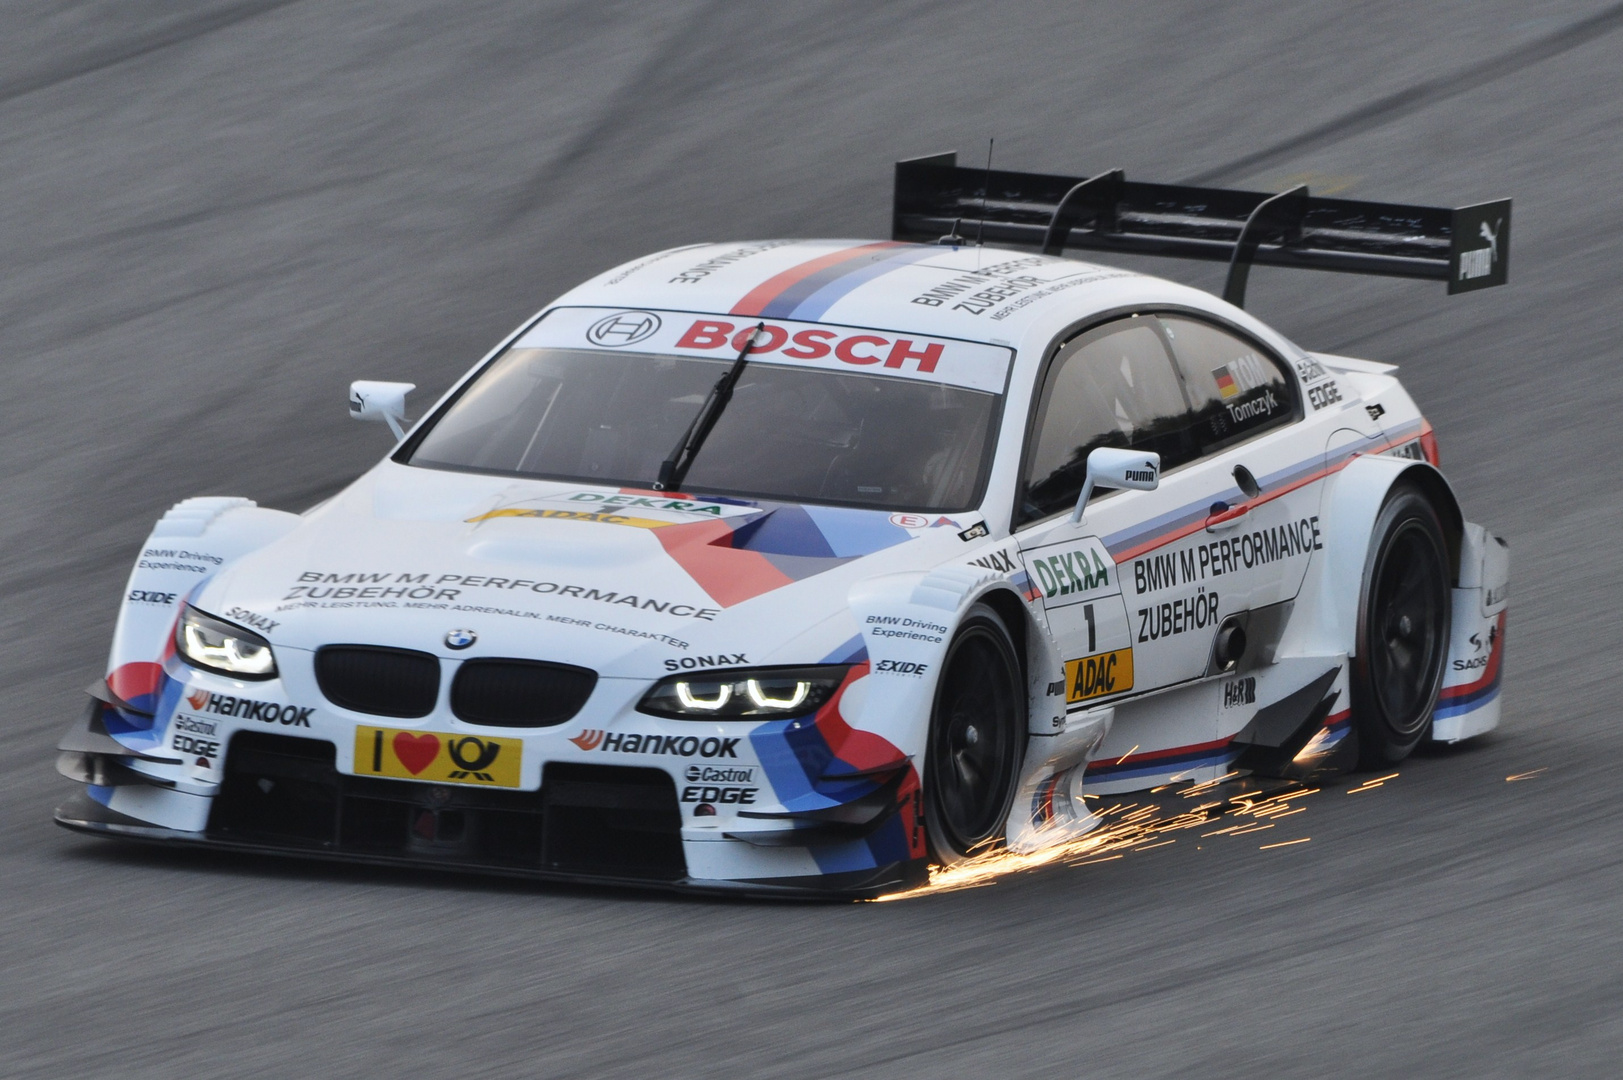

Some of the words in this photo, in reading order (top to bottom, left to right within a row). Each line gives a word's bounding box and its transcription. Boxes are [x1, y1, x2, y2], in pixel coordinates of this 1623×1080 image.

[910, 281, 972, 307] BMW
[675, 319, 945, 373] BOSCH
[1226, 389, 1278, 423] Tomczyk
[1308, 380, 1342, 411] EDGE
[1125, 470, 1154, 482] PUMA
[569, 493, 721, 515] DEKRA
[517, 509, 630, 524] ADAC
[138, 560, 207, 574] Experience
[143, 549, 177, 559] BMW
[179, 551, 224, 566] Driving
[967, 548, 1017, 573] NAX
[1134, 552, 1177, 595] BMW
[1180, 547, 1197, 584] M
[1199, 515, 1324, 580] PERFORMANCE
[1032, 547, 1109, 599] DEKRA
[129, 590, 177, 604] EXIDE
[282, 585, 462, 601] ZUBEHÖR
[297, 571, 392, 583] BMW
[395, 573, 430, 583] M
[435, 574, 722, 622] PERFORMANCE
[225, 606, 281, 634] SONAX
[275, 601, 318, 613] MEHR
[402, 602, 449, 610] MEHR
[546, 615, 592, 628] MEHR
[594, 623, 690, 650] CHARAKTER
[866, 615, 901, 626] BMW
[901, 618, 948, 634] Driving
[1137, 586, 1220, 644] ZUBEHÖR
[871, 627, 943, 644] Experience
[1083, 603, 1096, 652] 1
[664, 653, 750, 672] SONAX
[875, 660, 929, 675] EXIDE
[1452, 656, 1488, 671] SACHS
[1071, 651, 1118, 700] ADAC
[173, 734, 221, 758] EDGE
[373, 730, 383, 772] I
[702, 767, 753, 783] Castrol
[681, 786, 759, 804] EDGE
